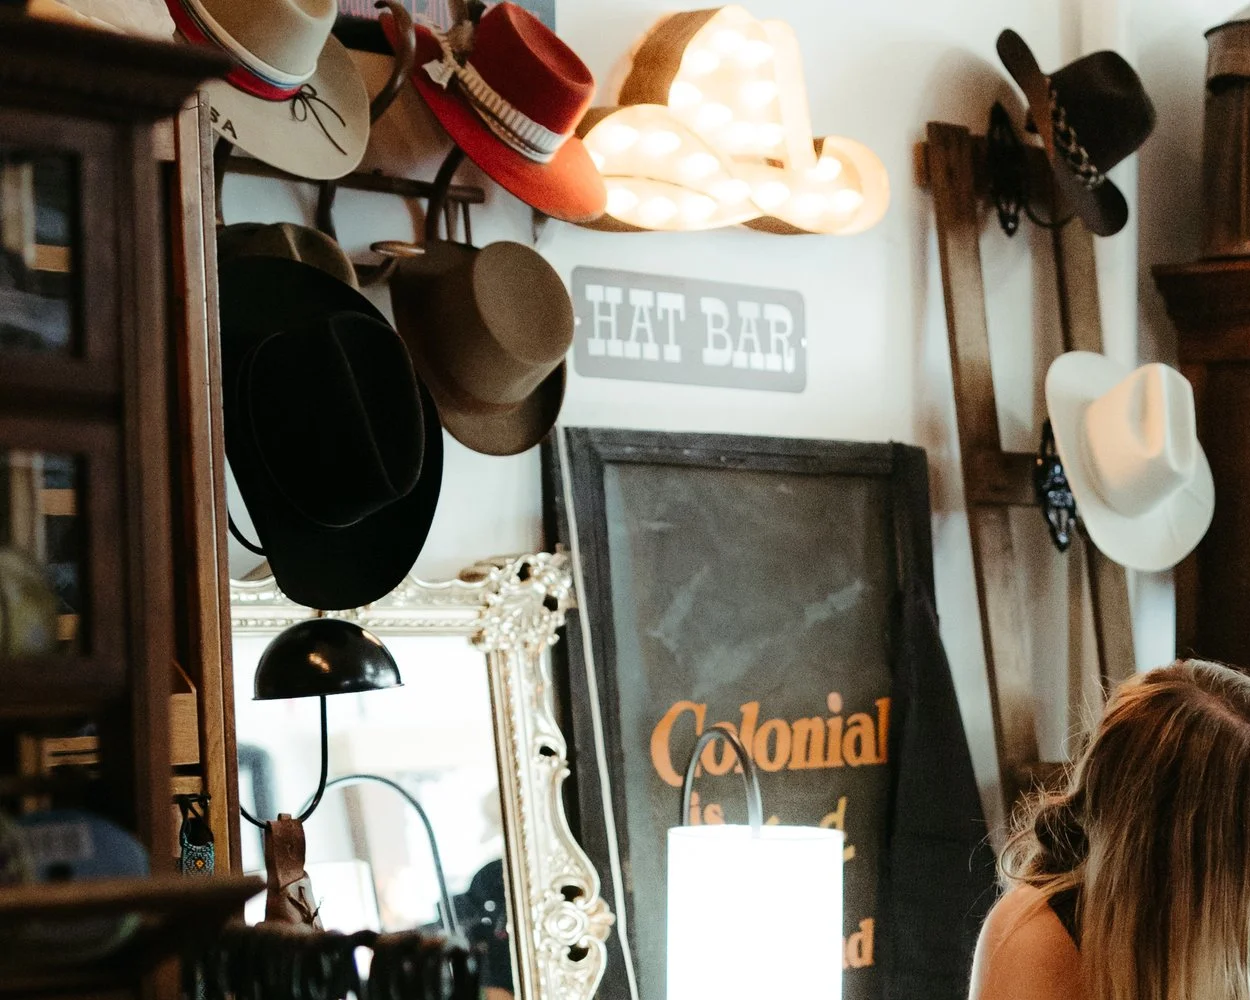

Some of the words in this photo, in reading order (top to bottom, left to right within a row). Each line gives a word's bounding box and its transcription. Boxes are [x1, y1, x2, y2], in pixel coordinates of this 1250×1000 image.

[585, 284, 686, 363] HAT
[700, 297, 796, 373] BAR
[650, 692, 892, 788] Colonial
